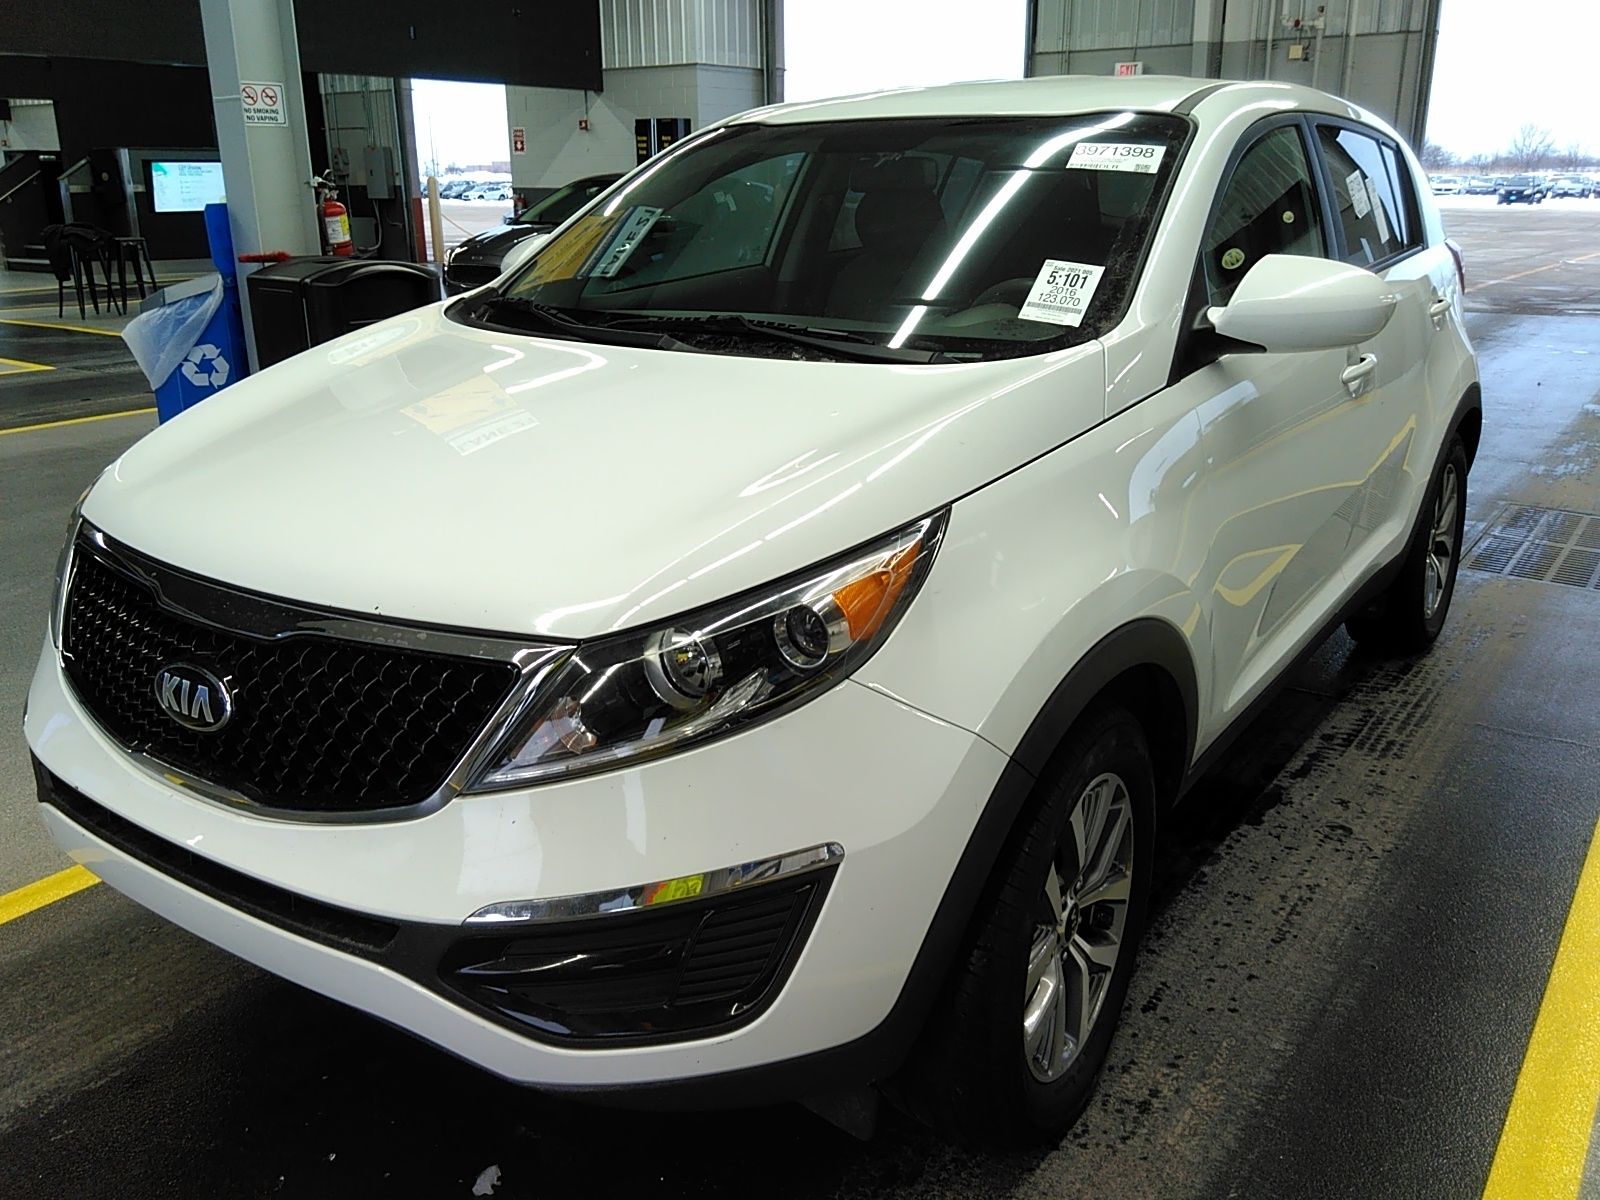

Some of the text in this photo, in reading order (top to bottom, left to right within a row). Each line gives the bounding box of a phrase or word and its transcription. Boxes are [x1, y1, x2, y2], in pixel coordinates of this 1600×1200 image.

[1119, 64, 1139, 76] EXIT
[253, 107, 280, 115] SMOKING
[1075, 145, 1156, 158] 3971398
[1046, 270, 1089, 289] 5:101
[1049, 285, 1078, 297] 2016
[161, 671, 215, 723] KIA
